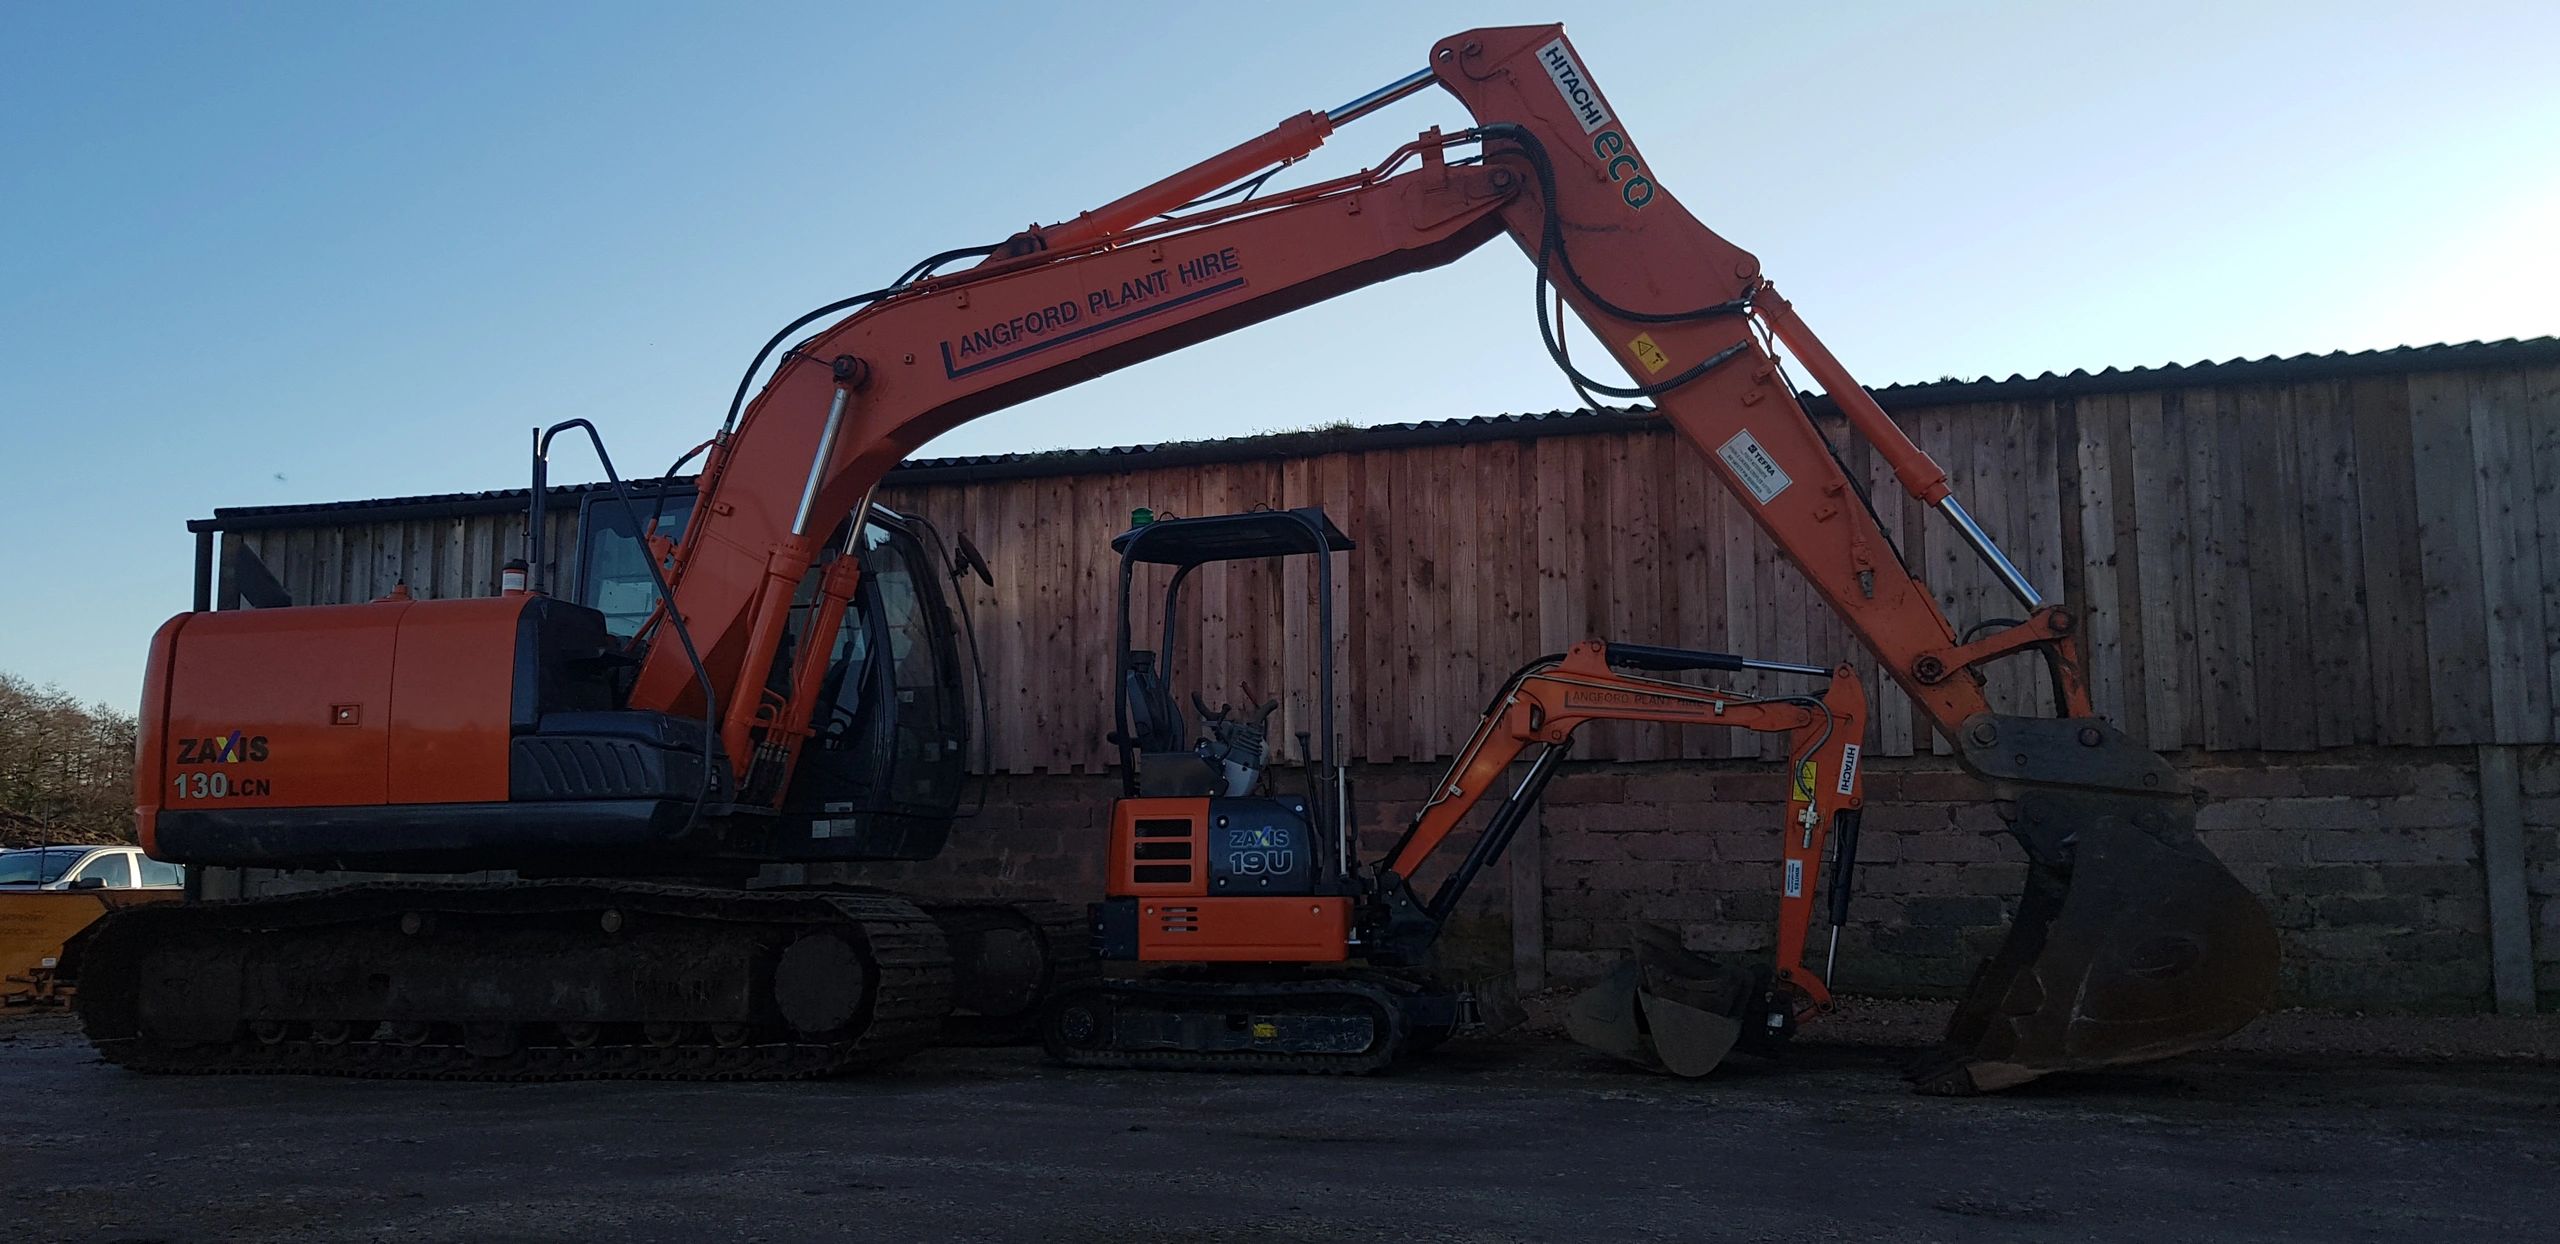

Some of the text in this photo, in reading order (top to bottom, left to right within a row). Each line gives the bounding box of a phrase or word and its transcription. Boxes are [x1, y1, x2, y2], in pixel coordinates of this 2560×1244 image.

[1545, 46, 1602, 125] HITACHI
[1592, 129, 1655, 212] eco
[939, 246, 1240, 380] LANGFORD PLANT HIRE
[1754, 452, 1775, 477] TEFRA
[176, 730, 269, 764] ZAXIS
[1840, 747, 1856, 791] HITACHI
[1229, 826, 1289, 848] ZAXIS
[1229, 850, 1293, 875] 19U
